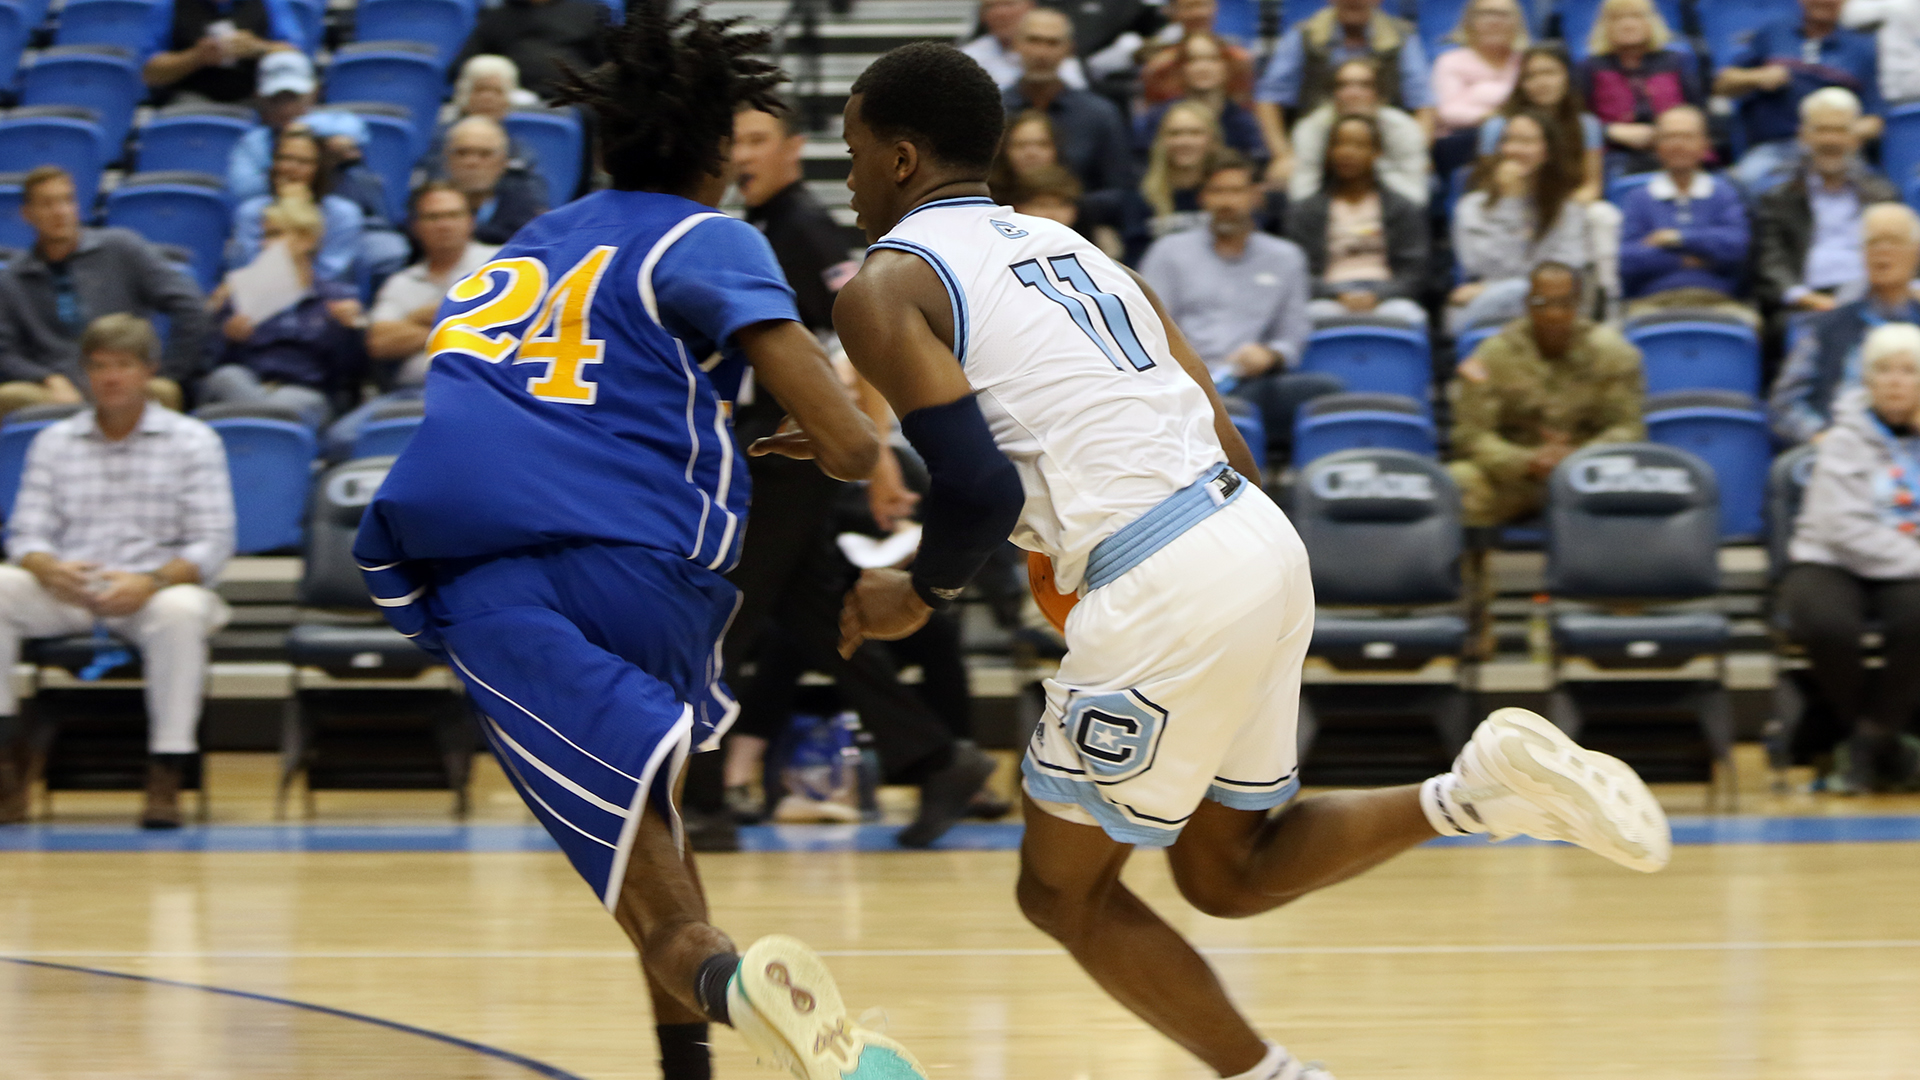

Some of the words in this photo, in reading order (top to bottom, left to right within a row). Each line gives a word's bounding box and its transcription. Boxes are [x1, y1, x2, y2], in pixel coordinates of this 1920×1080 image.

[425, 245, 619, 405] 24
[1009, 253, 1156, 372] 11
[1074, 707, 1141, 764] C
